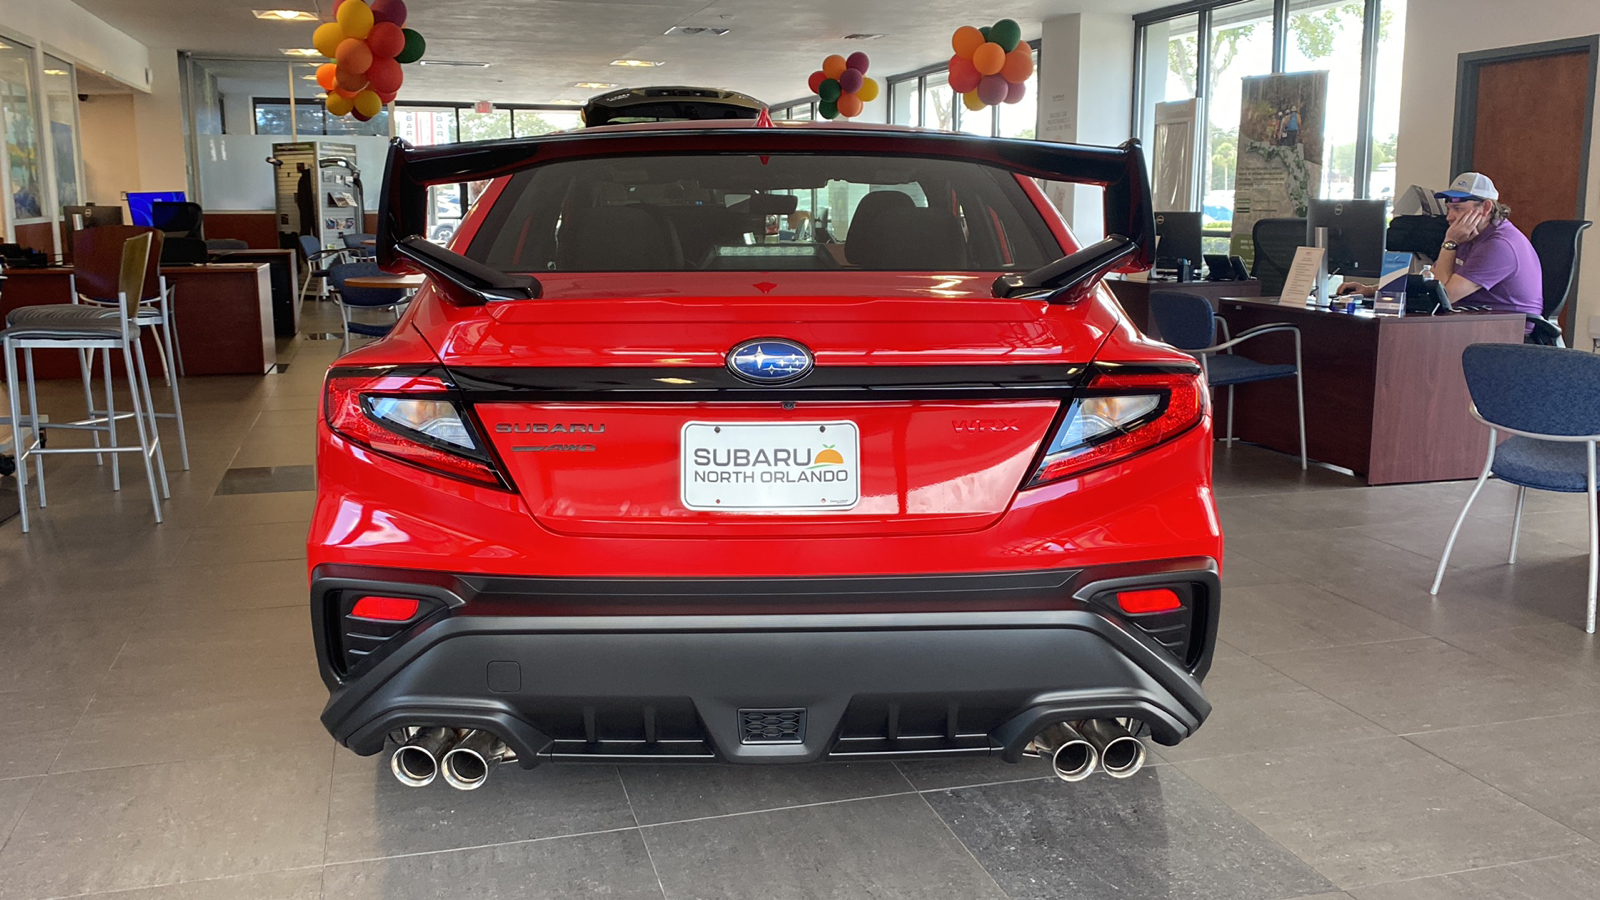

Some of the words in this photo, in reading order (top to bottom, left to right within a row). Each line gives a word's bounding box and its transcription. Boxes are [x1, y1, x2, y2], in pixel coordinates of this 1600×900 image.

[495, 423, 605, 433] SUBARU
[952, 418, 1019, 433] WRX
[544, 443, 596, 452] AWD
[694, 448, 811, 467] SUBARU
[694, 470, 755, 483] NORTH
[760, 469, 848, 483] ORLANDO
